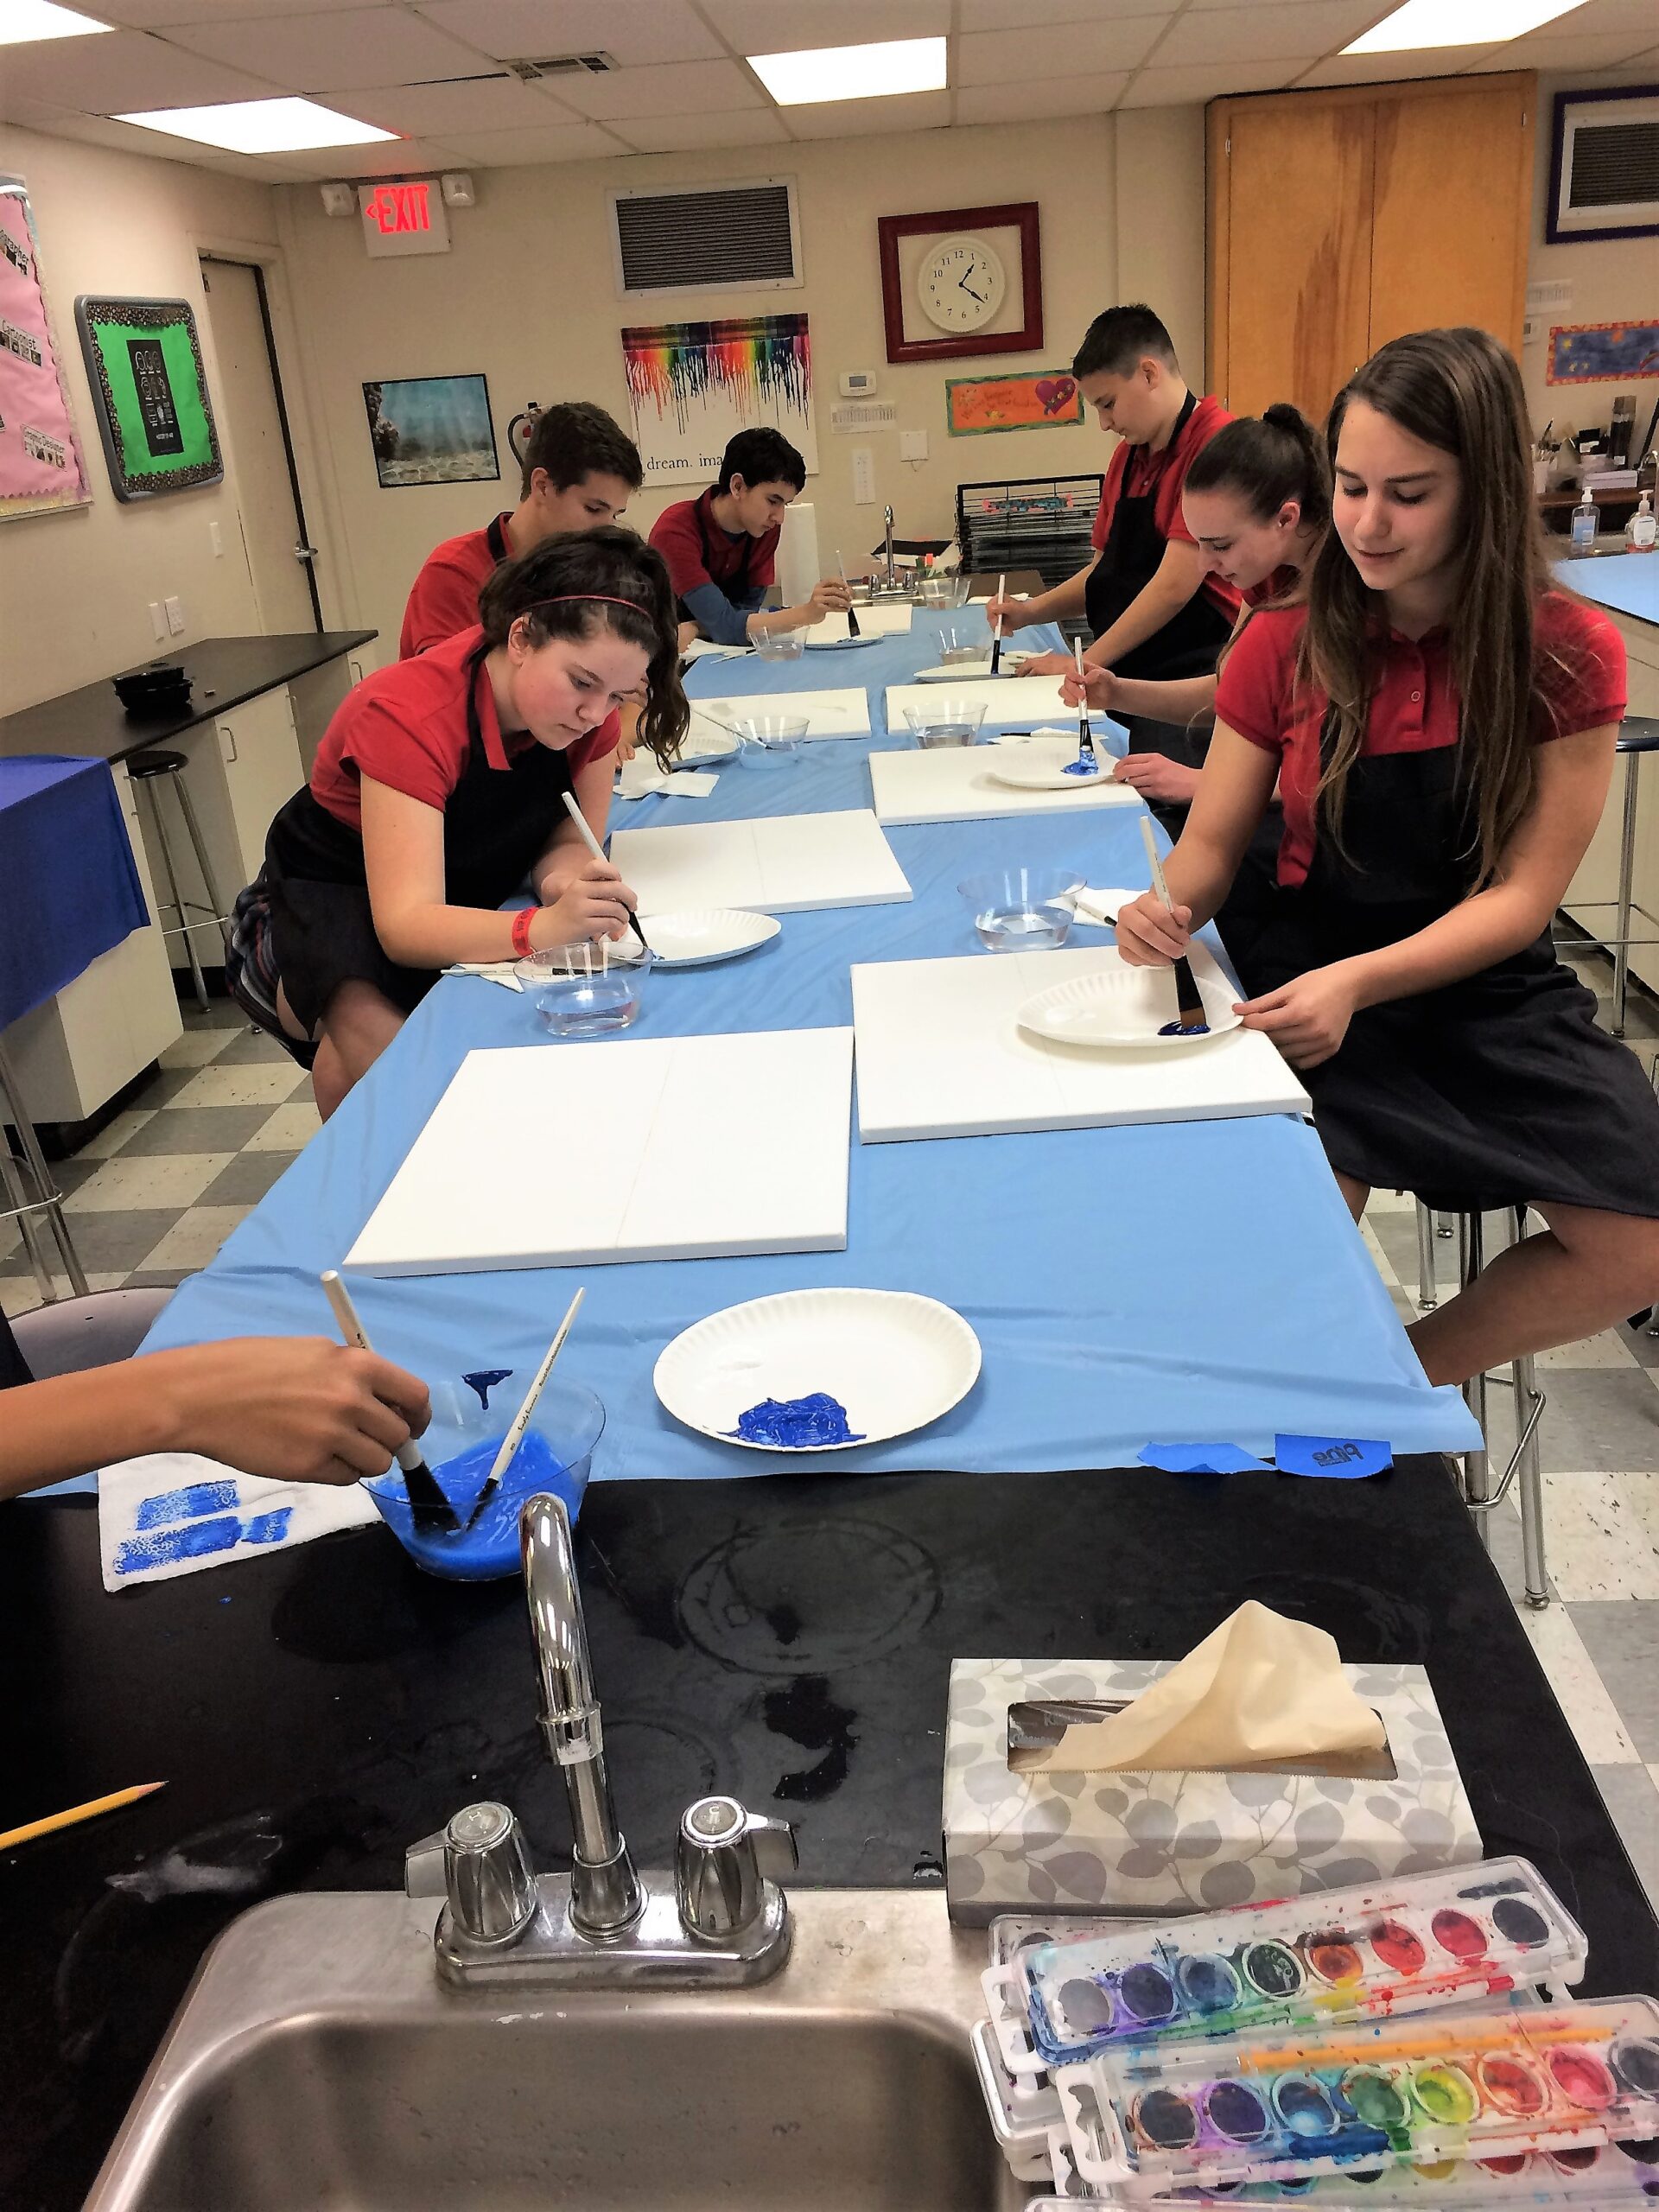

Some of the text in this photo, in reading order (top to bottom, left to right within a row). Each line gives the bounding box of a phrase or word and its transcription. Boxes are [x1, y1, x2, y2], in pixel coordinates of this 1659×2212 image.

[374, 184, 429, 233] EXIT
[954, 251, 963, 259] 12
[933, 270, 943, 278] 10
[947, 308, 952, 316] 7
[975, 305, 980, 314] 5
[646, 456, 693, 470] dream.
